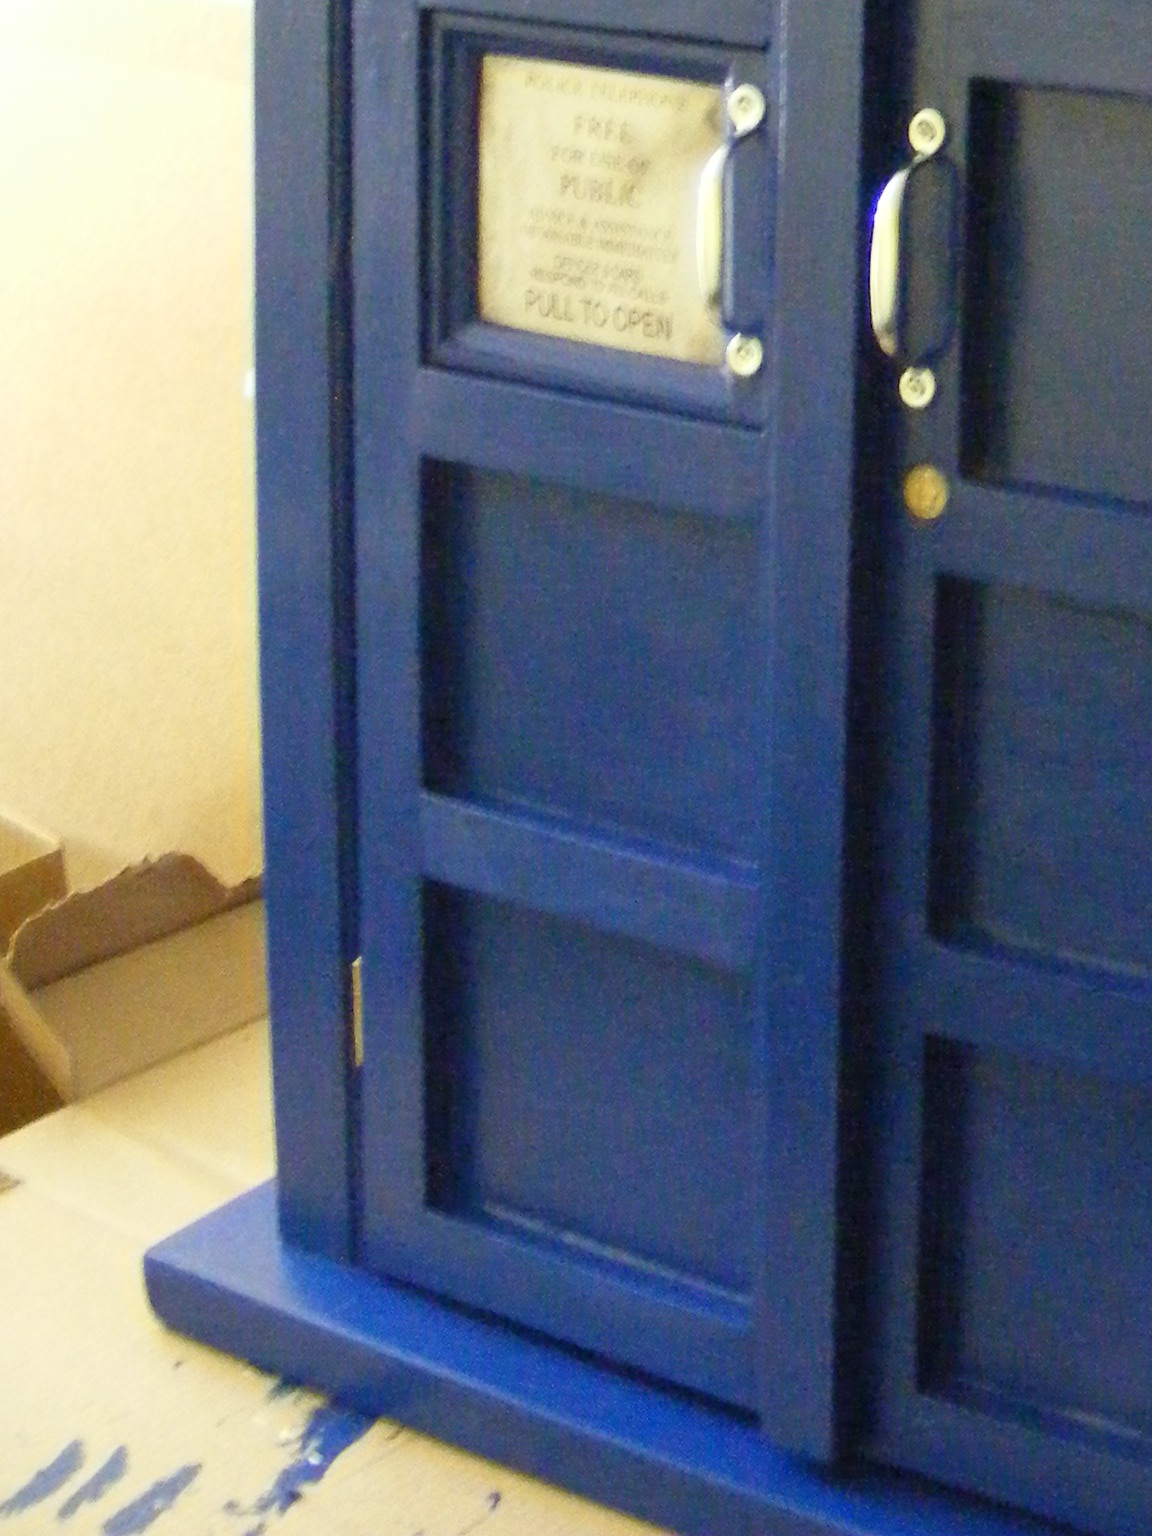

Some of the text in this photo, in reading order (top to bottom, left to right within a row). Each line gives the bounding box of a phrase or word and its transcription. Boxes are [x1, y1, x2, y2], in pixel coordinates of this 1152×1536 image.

[559, 173, 643, 210] PUBLIC
[523, 288, 675, 343] PULL TO OPEN
